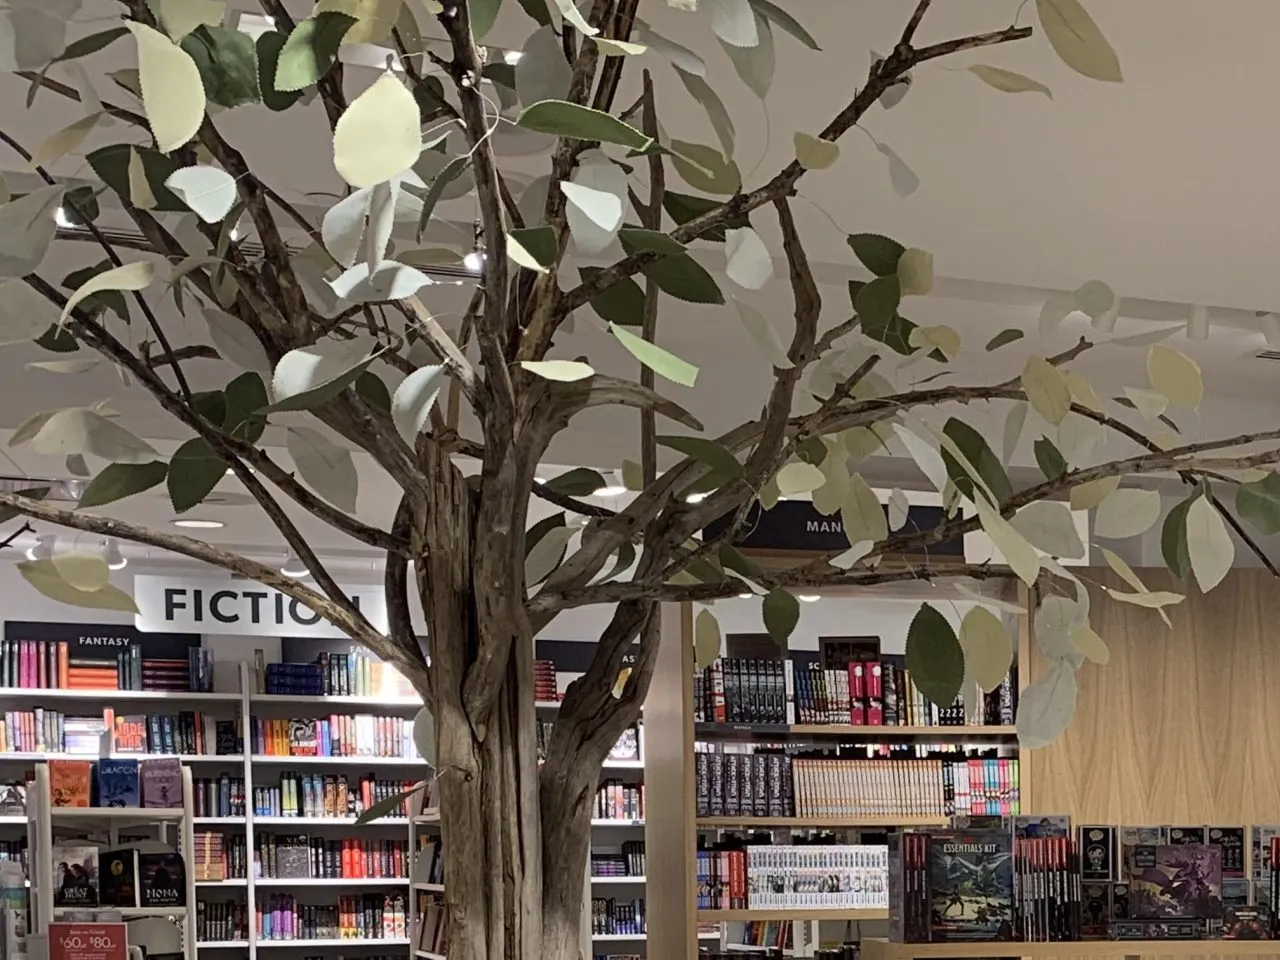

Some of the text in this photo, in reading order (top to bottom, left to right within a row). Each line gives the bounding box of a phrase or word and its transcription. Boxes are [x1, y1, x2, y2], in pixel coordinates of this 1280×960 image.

[806, 520, 843, 533] MAN
[79, 636, 130, 646] FANTASY
[943, 844, 997, 853] ESSENTIALS KIT
[146, 888, 179, 899] NONA
